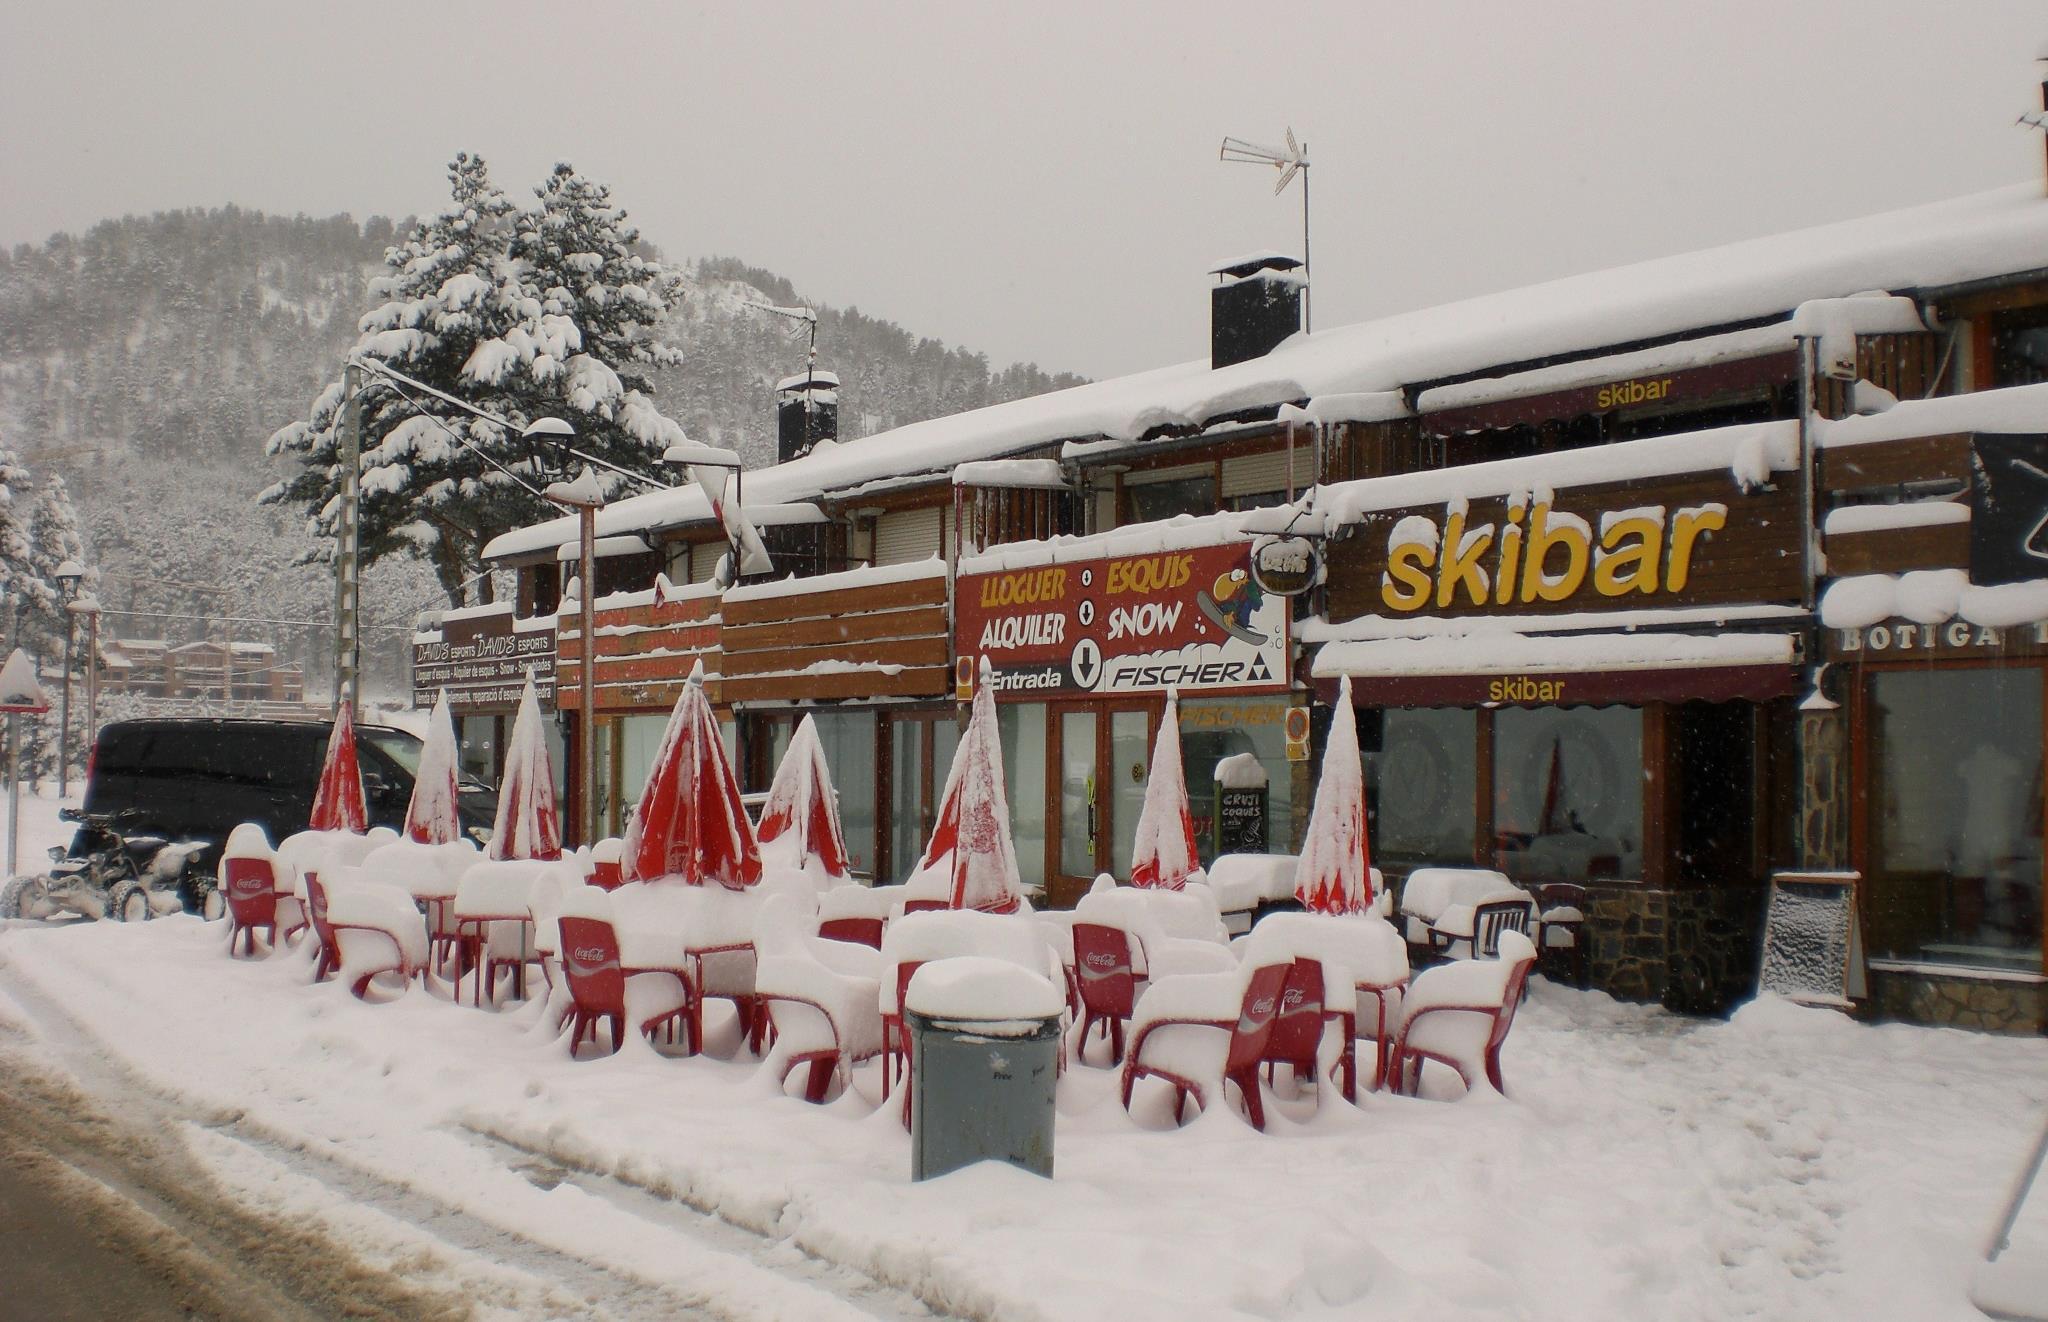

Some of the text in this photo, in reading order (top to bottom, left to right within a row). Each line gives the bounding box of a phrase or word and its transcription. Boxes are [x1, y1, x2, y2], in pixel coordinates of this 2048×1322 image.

[1597, 379, 1672, 408] skibar
[1381, 501, 1727, 612] skibar
[981, 569, 1067, 608] LLOGUER
[1106, 554, 1195, 595] ESQUIS
[979, 613, 1066, 650] ALQUILER
[1107, 601, 1183, 641] SNOW
[477, 635, 548, 658] DAVID'S ESPORTS
[1841, 623, 2000, 651] BOTIGA
[991, 667, 1061, 691] Entrada
[1112, 661, 1245, 687] FISCHER
[1489, 676, 1565, 702] skibar
